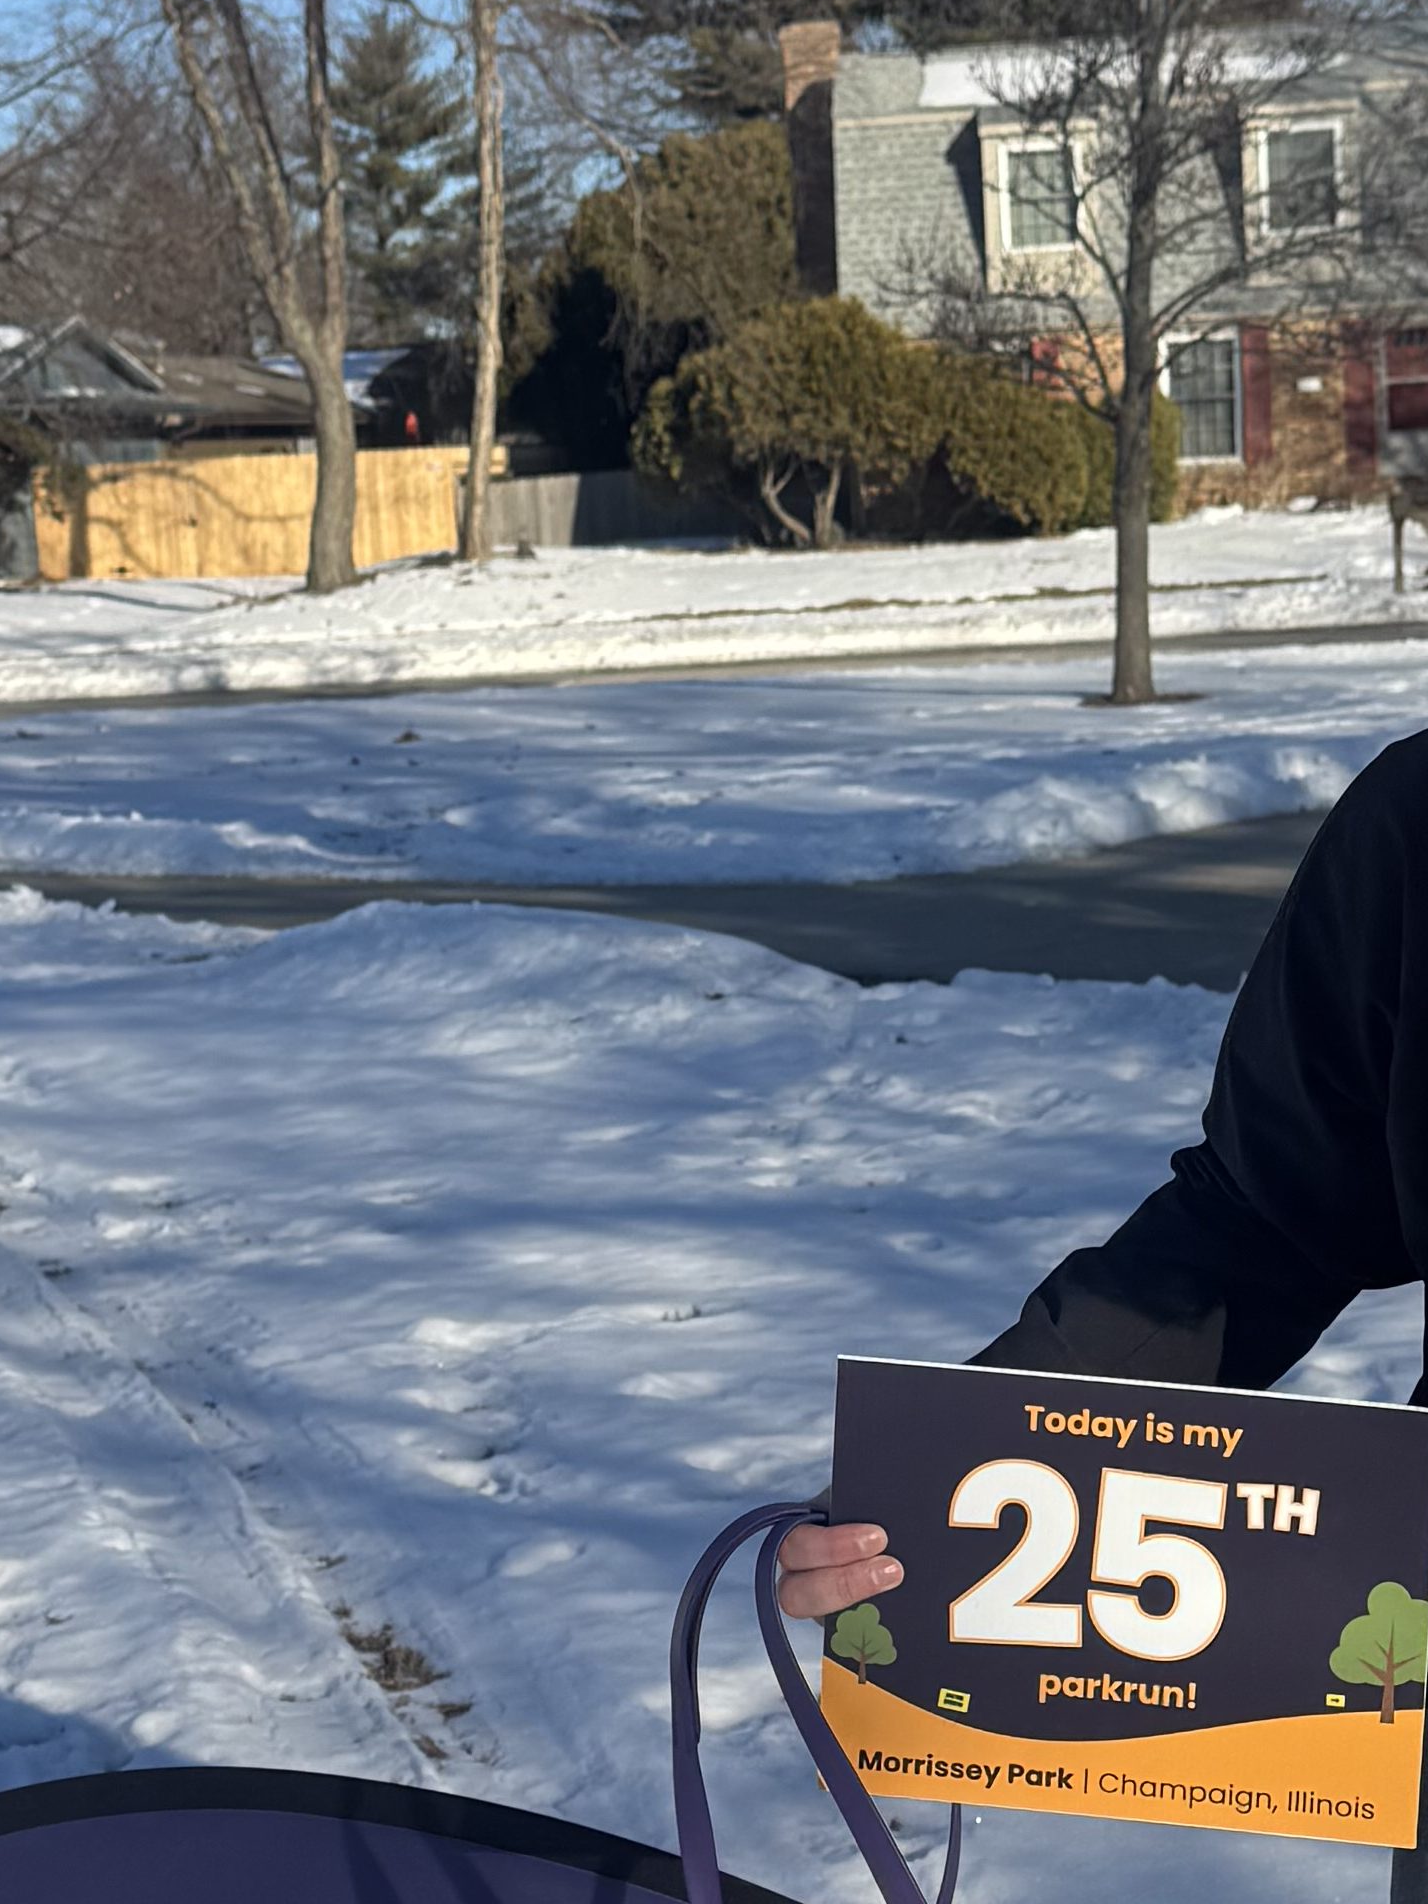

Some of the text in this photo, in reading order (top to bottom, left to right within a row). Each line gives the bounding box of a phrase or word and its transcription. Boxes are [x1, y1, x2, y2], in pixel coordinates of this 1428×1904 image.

[1024, 1404, 1244, 1458] Today is my
[1038, 1671, 1198, 1710] parkrun!
[858, 1749, 1376, 1821] Morrissey Park Champaign, Illinois
